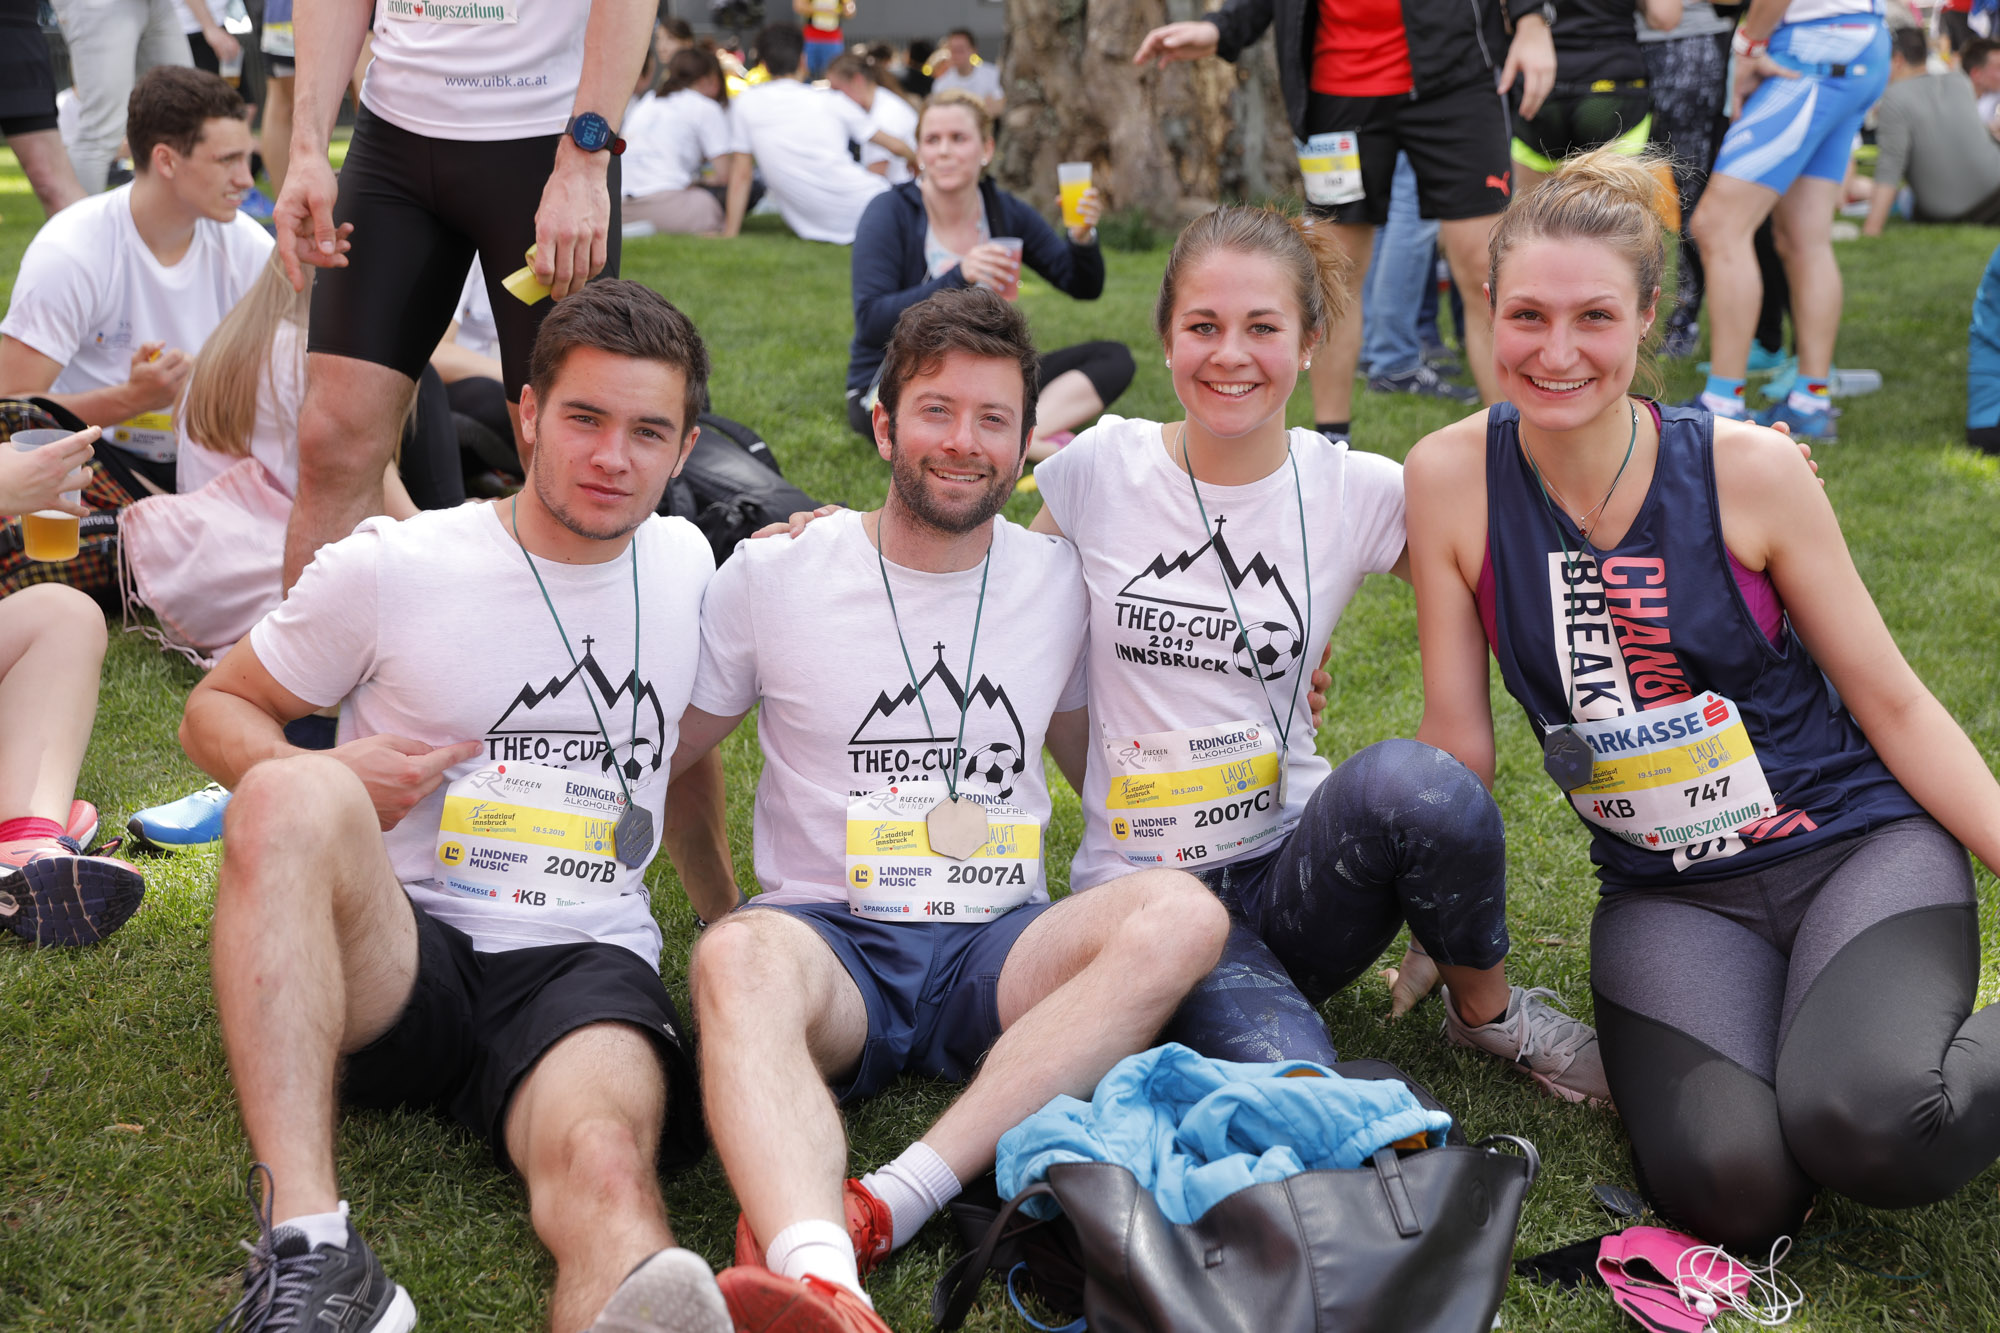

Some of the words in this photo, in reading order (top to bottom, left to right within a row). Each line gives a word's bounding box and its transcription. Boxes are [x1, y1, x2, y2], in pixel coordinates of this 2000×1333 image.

[422, 0, 504, 21] Tageszeitung
[445, 74, 548, 88] www.uibk.ac.at
[1114, 602, 1238, 642] THEO-CUP
[1149, 635, 1194, 651] 2019
[1560, 560, 1623, 709] BREAK
[1601, 556, 1695, 710] CHANG
[1114, 642, 1230, 675] INNSBRUCK
[1188, 731, 1247, 751] ERDINGER
[1585, 711, 1704, 755] ARKASSE
[484, 736, 609, 762] THEO-CUP
[1191, 740, 1263, 761] ALKOHOLFREI
[848, 747, 968, 773] THEO-CUP
[1638, 767, 1672, 779] 19.5.2019
[565, 781, 616, 803] ERDINGER
[1171, 785, 1204, 796] 19.5.2019
[1683, 775, 1731, 808] 747
[563, 797, 623, 814] ALKOHOLFRE
[1193, 790, 1270, 828] 2007C
[483, 813, 516, 821] stadtlauf
[1132, 817, 1177, 828] LINDNER
[1654, 802, 1761, 844] Tageszeitung
[532, 825, 566, 837] 19.5.2019
[1134, 829, 1165, 838] MUSIC
[469, 858, 510, 873] MUSIC
[470, 847, 529, 865] LINDNER
[543, 856, 617, 884] 2007B
[879, 867, 932, 877] LINDNER
[947, 863, 1026, 886] 2007A
[449, 881, 489, 897] SPARKASSE
[879, 877, 917, 887] MUSIC
[863, 905, 902, 913] SPARKASSE
